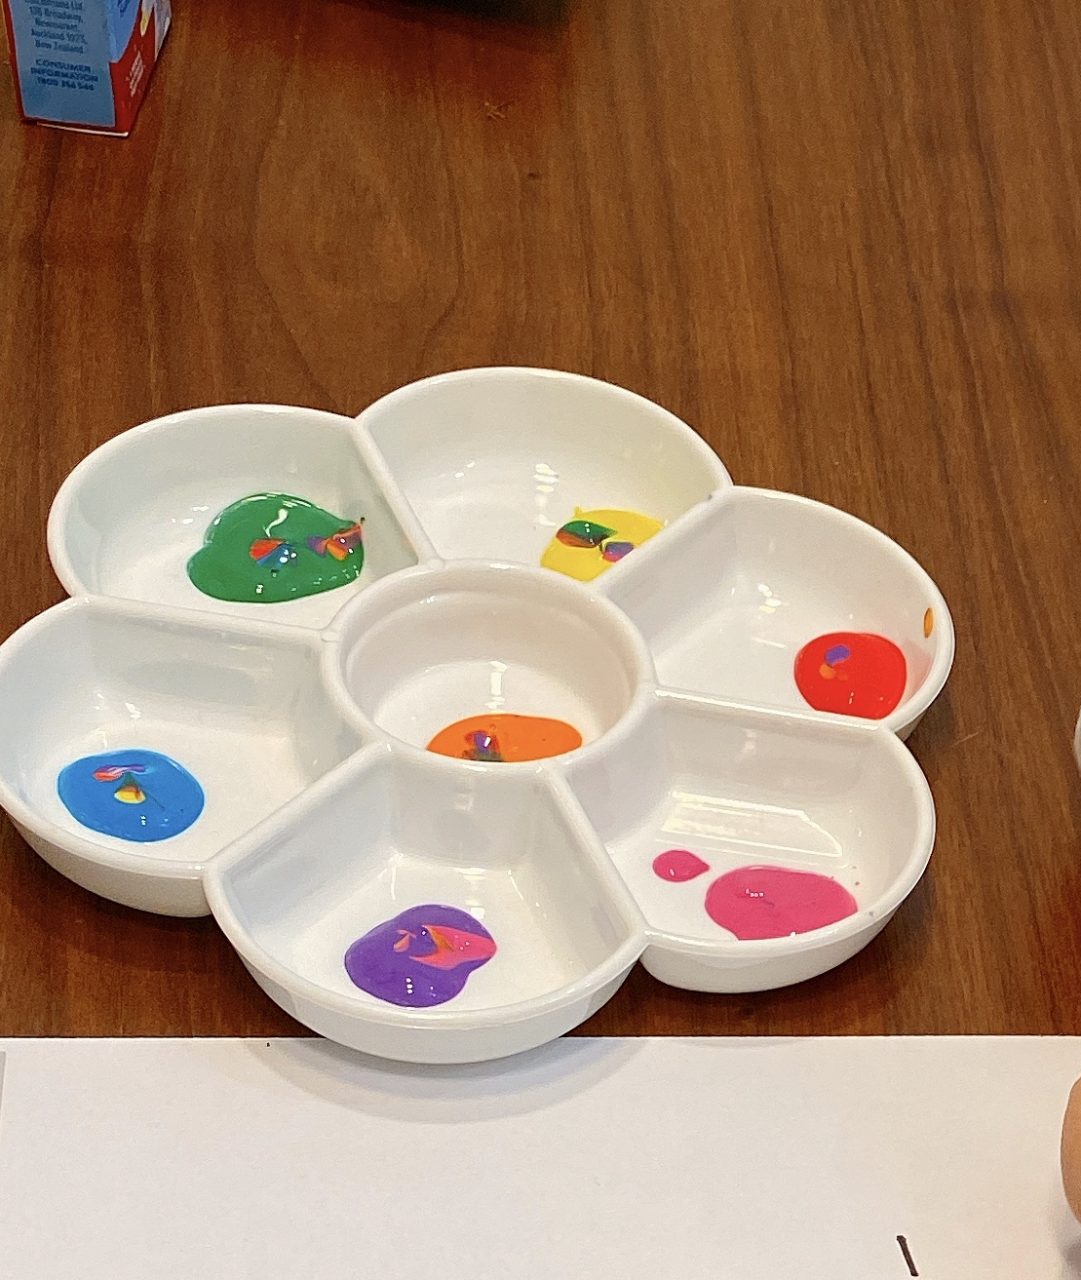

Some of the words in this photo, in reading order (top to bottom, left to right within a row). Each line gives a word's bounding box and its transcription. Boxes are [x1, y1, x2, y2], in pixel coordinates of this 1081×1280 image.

[31, 27, 65, 41] Auckland
[34, 38, 52, 49] New
[35, 58, 91, 73] CONSUMER
[30, 67, 98, 82] INFORMATION
